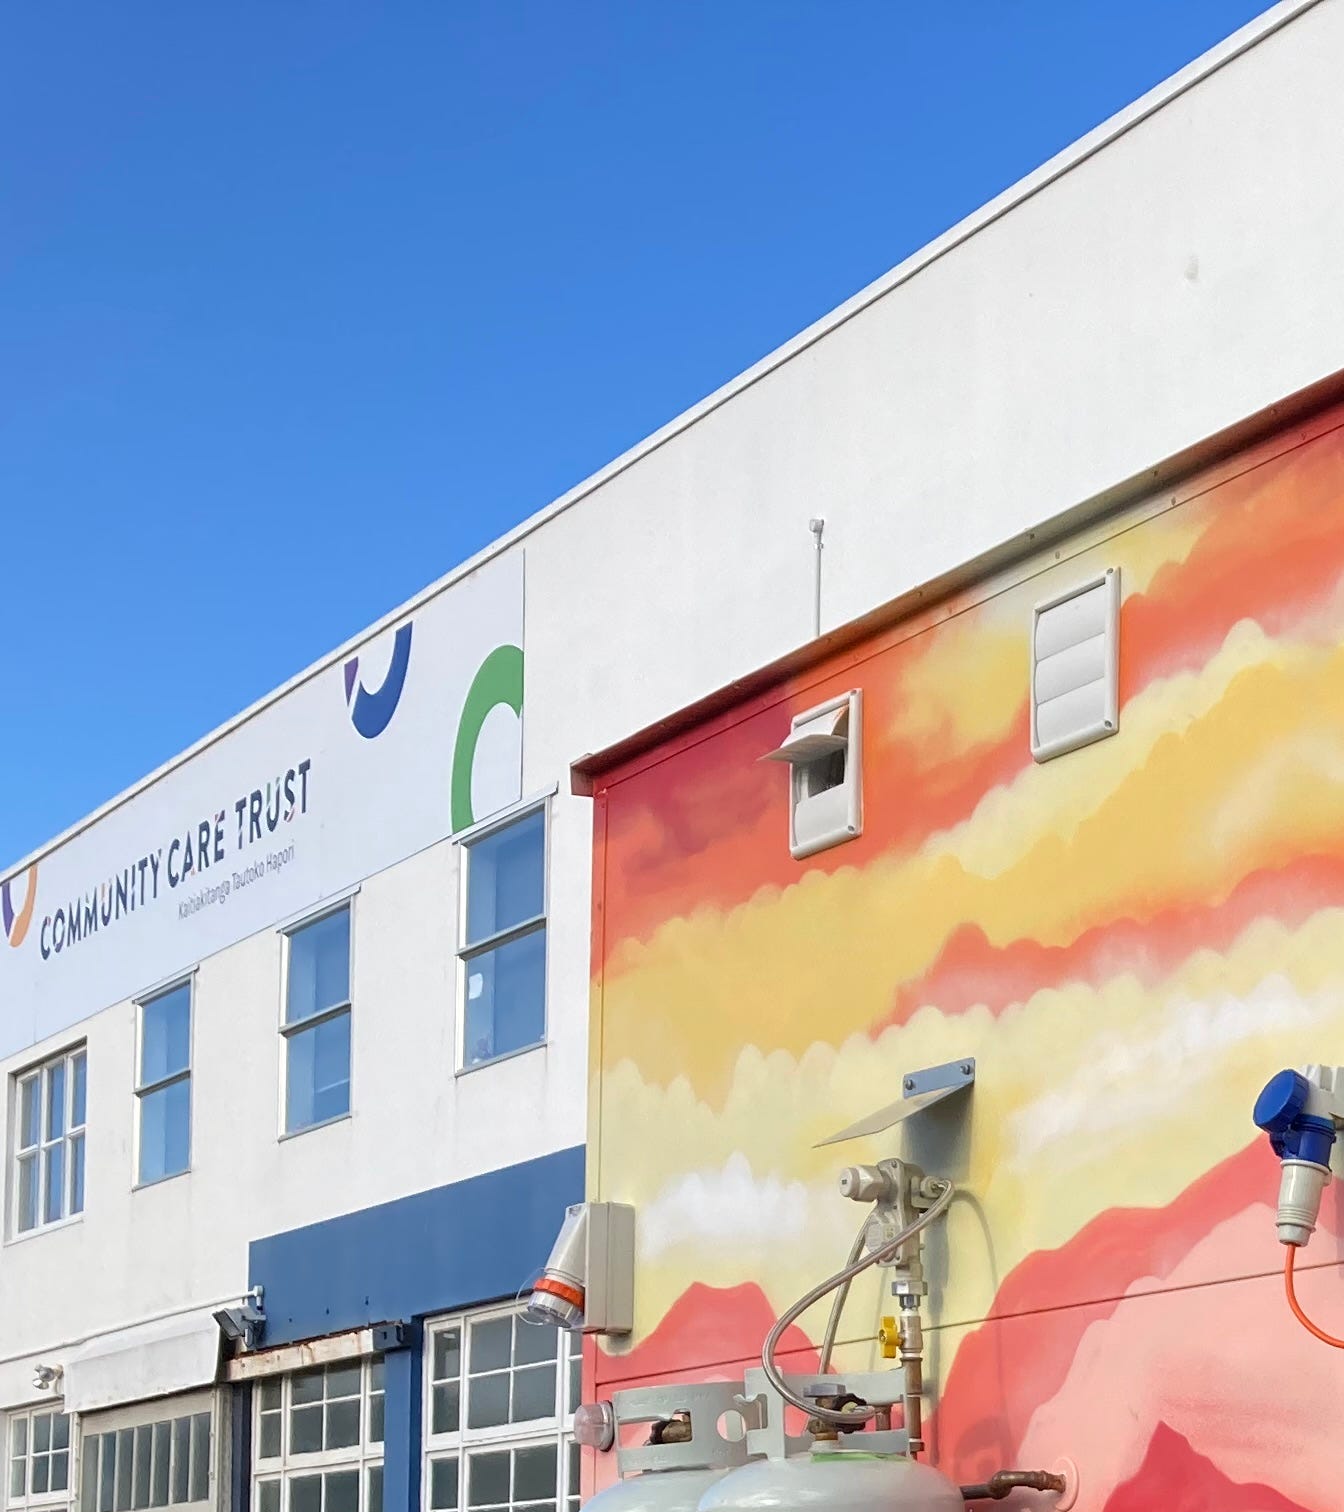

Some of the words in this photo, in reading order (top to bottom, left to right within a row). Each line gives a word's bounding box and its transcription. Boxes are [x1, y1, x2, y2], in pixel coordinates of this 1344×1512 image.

[40, 848, 162, 960] COMMUNITY
[167, 809, 225, 889] CARE
[235, 758, 311, 850] TRUST
